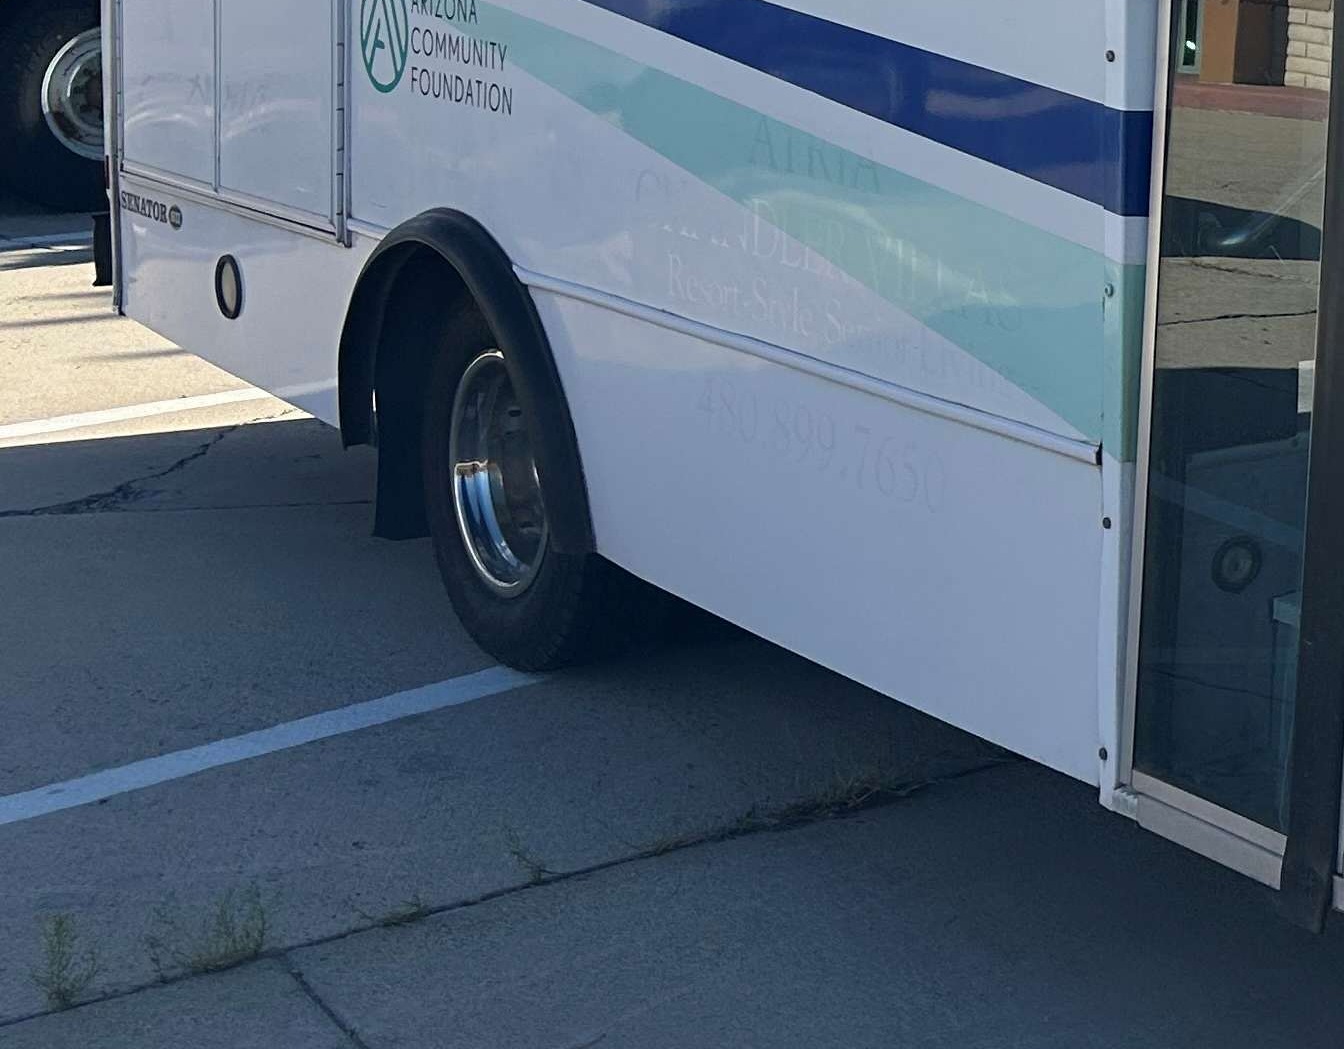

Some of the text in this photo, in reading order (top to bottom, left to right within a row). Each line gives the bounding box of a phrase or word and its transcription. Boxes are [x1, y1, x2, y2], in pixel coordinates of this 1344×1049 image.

[411, 27, 507, 71] COMMUNITY
[411, 66, 513, 115] FOUNDATION
[121, 190, 168, 223] SENATOR
